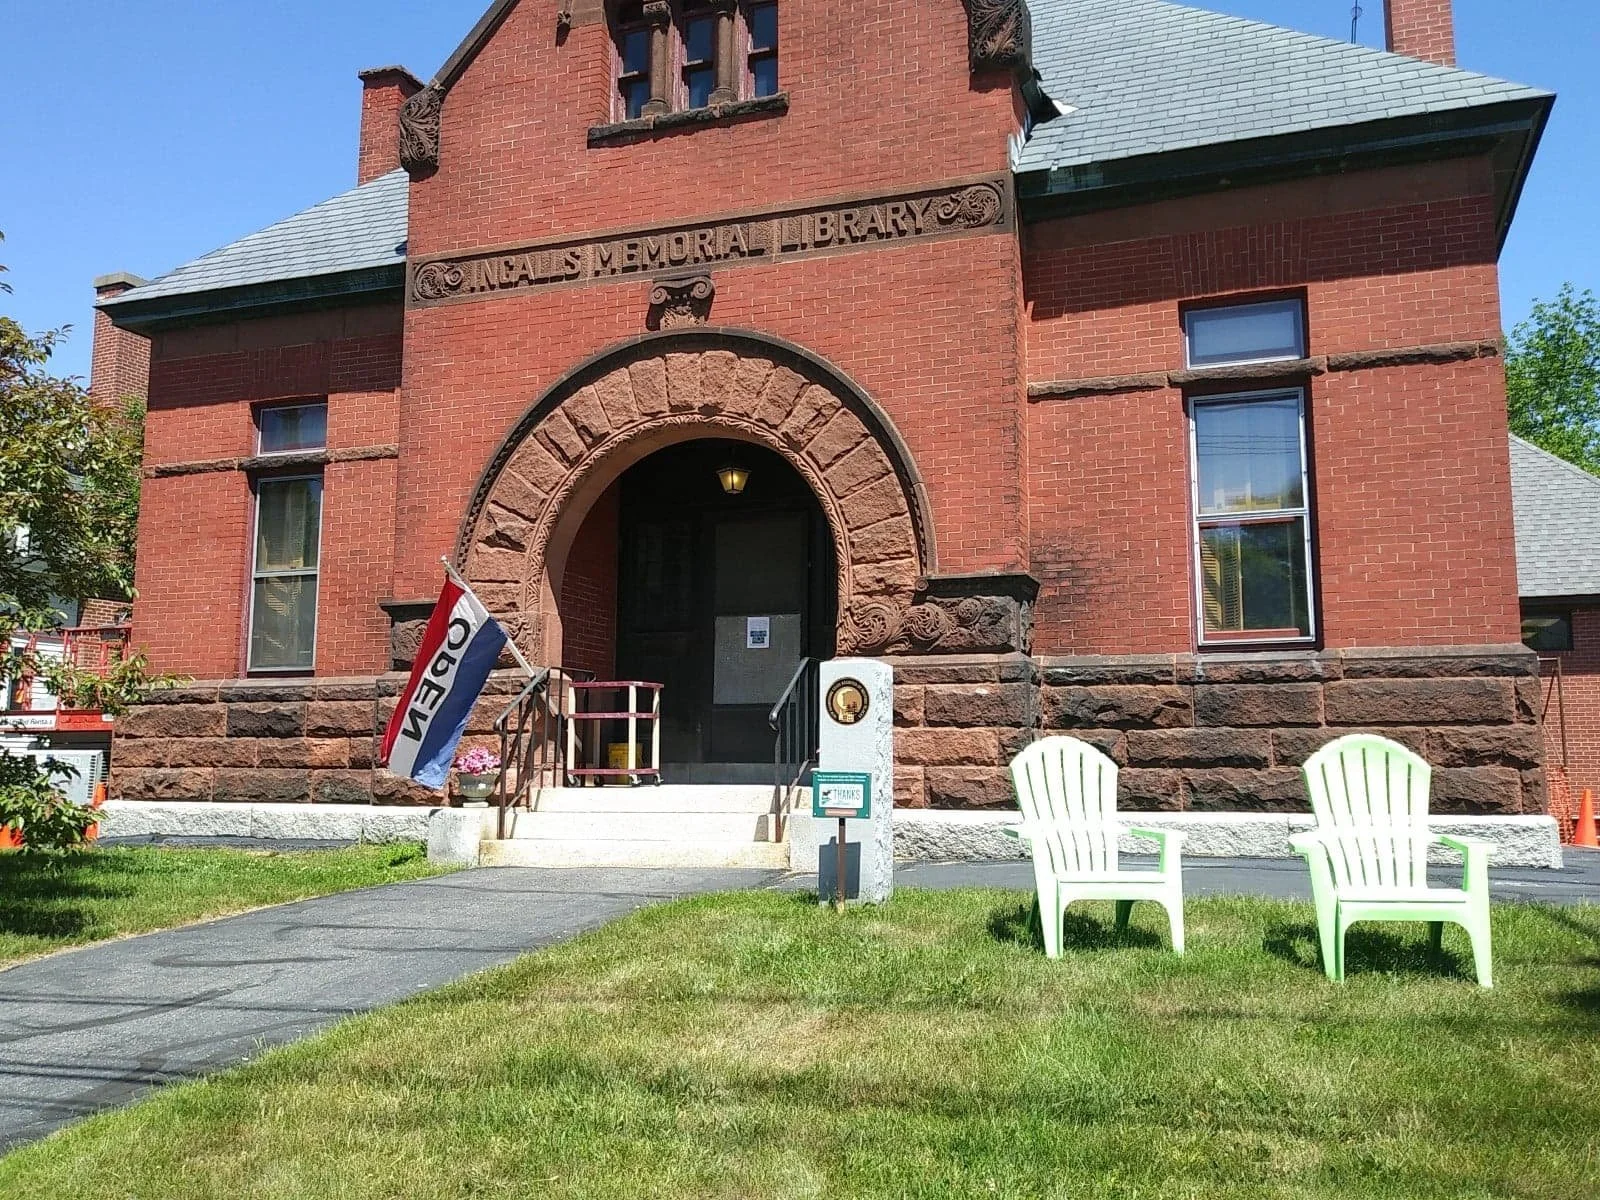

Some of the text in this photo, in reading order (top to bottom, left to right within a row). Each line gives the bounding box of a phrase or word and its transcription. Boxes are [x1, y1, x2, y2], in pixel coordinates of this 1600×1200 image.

[471, 200, 931, 291] INGALLS MEMORIAL LIBRARY
[832, 788, 861, 801] THANKS
